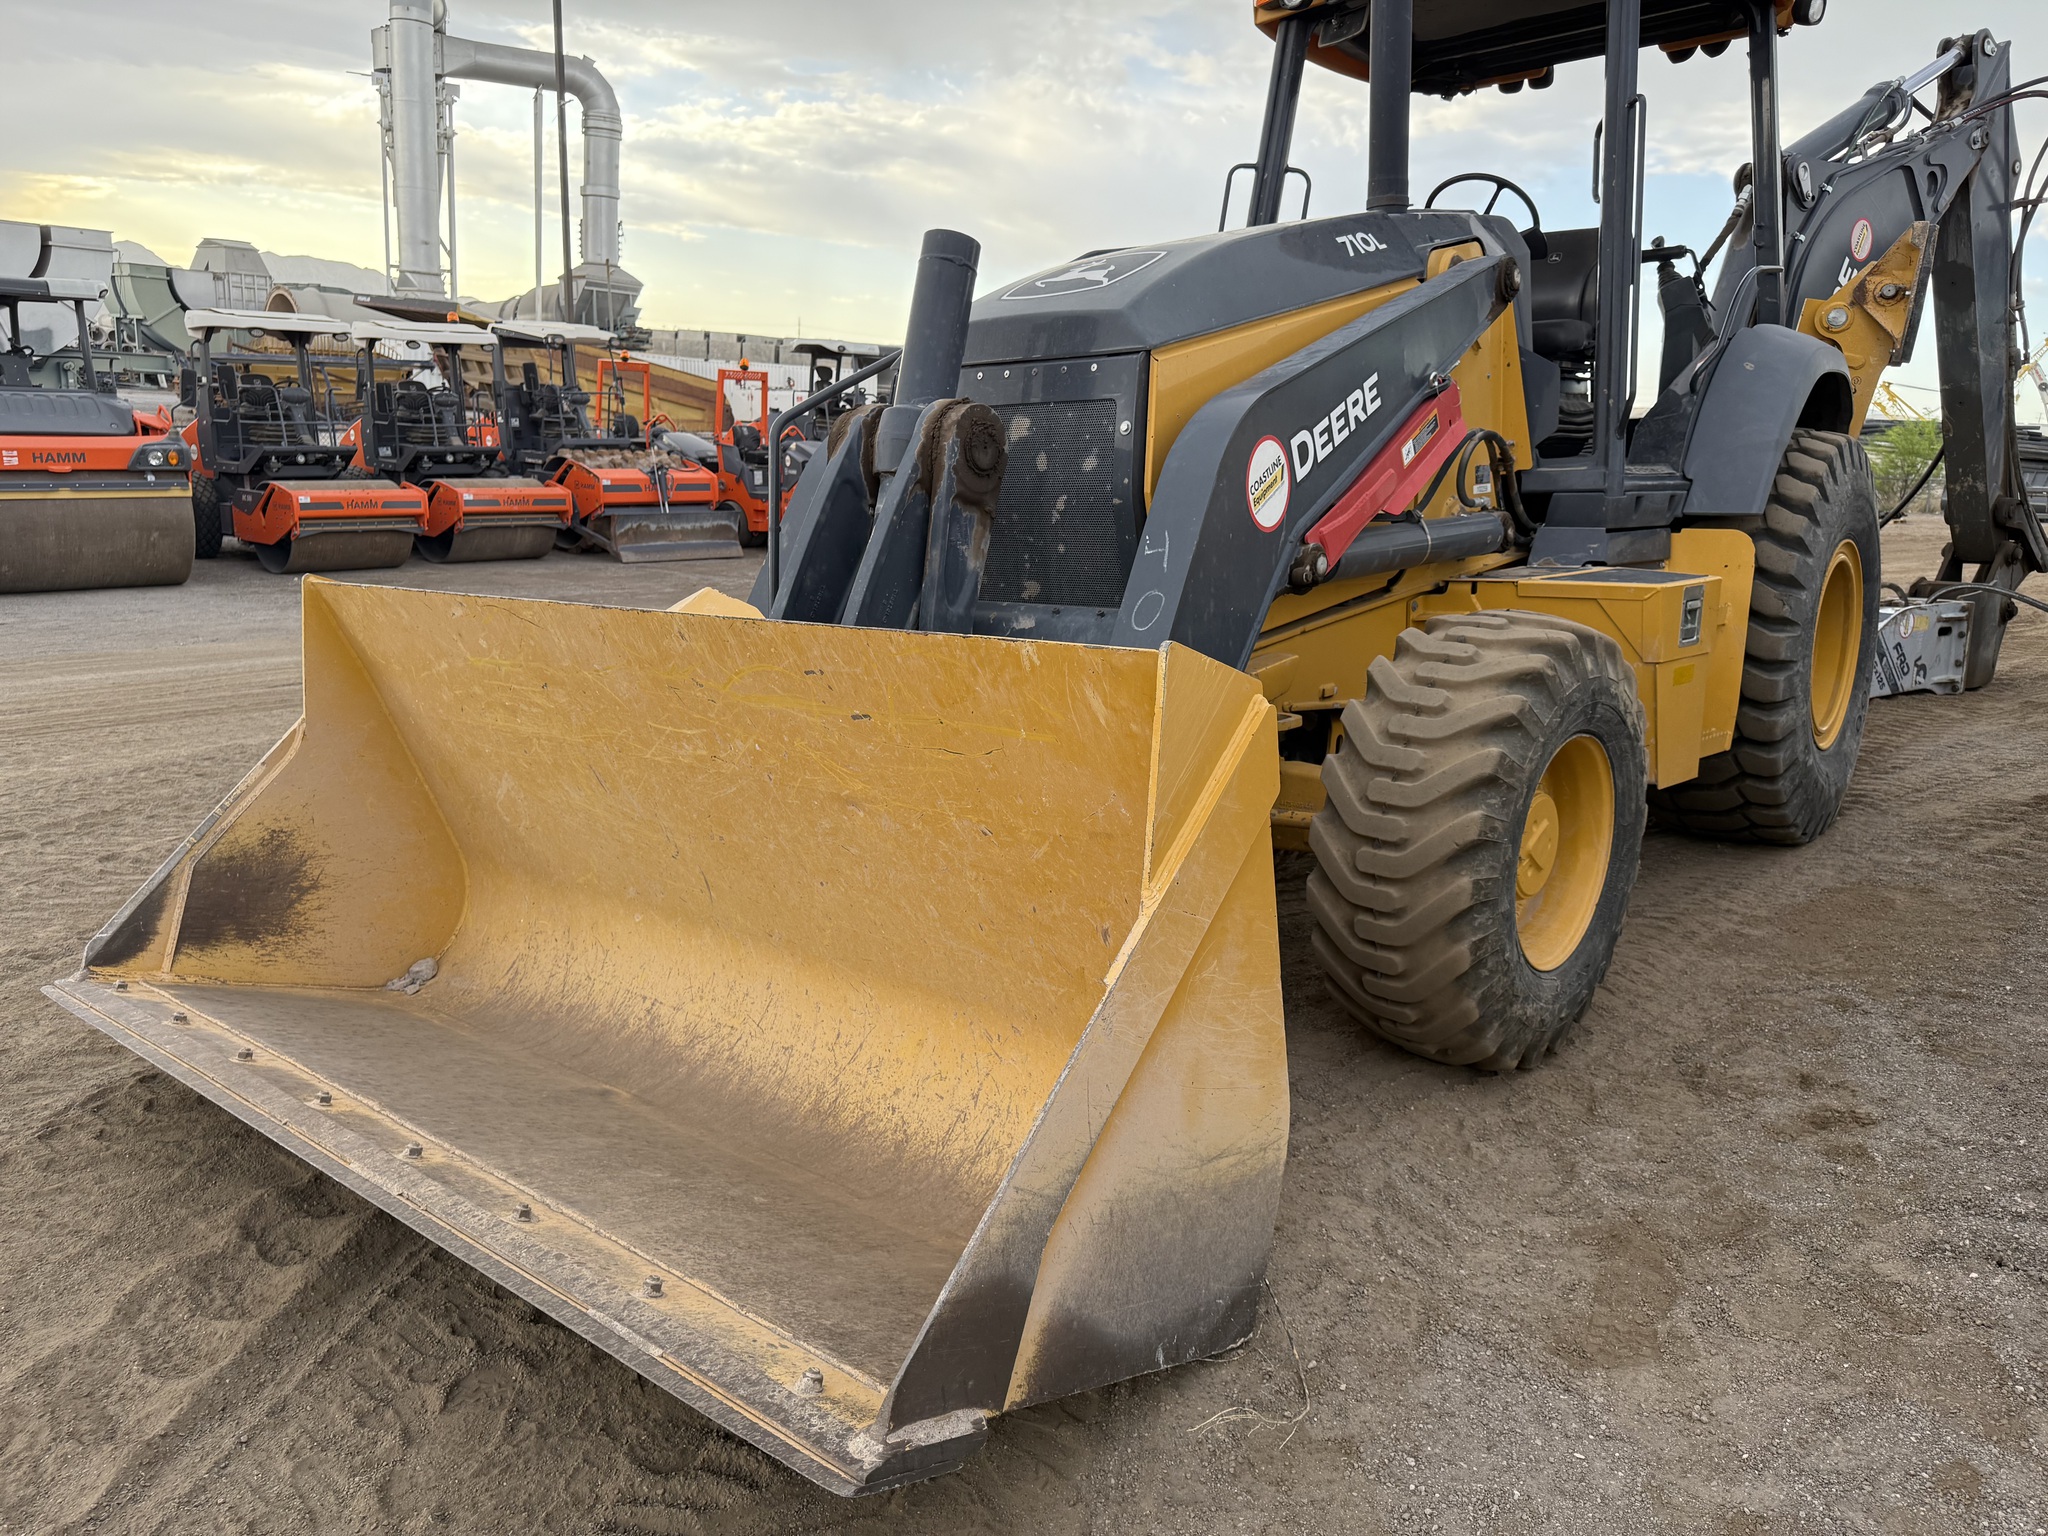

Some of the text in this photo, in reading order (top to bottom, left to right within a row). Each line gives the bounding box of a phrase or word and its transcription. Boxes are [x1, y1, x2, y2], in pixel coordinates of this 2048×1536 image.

[1335, 231, 1388, 257] 710L
[1290, 371, 1382, 483] DEERE
[32, 452, 87, 464] HAMM
[1249, 454, 1283, 496] COASTLINE
[503, 497, 530, 507] HAMM
[1252, 475, 1279, 507] Equipment
[346, 500, 379, 510] HAMM
